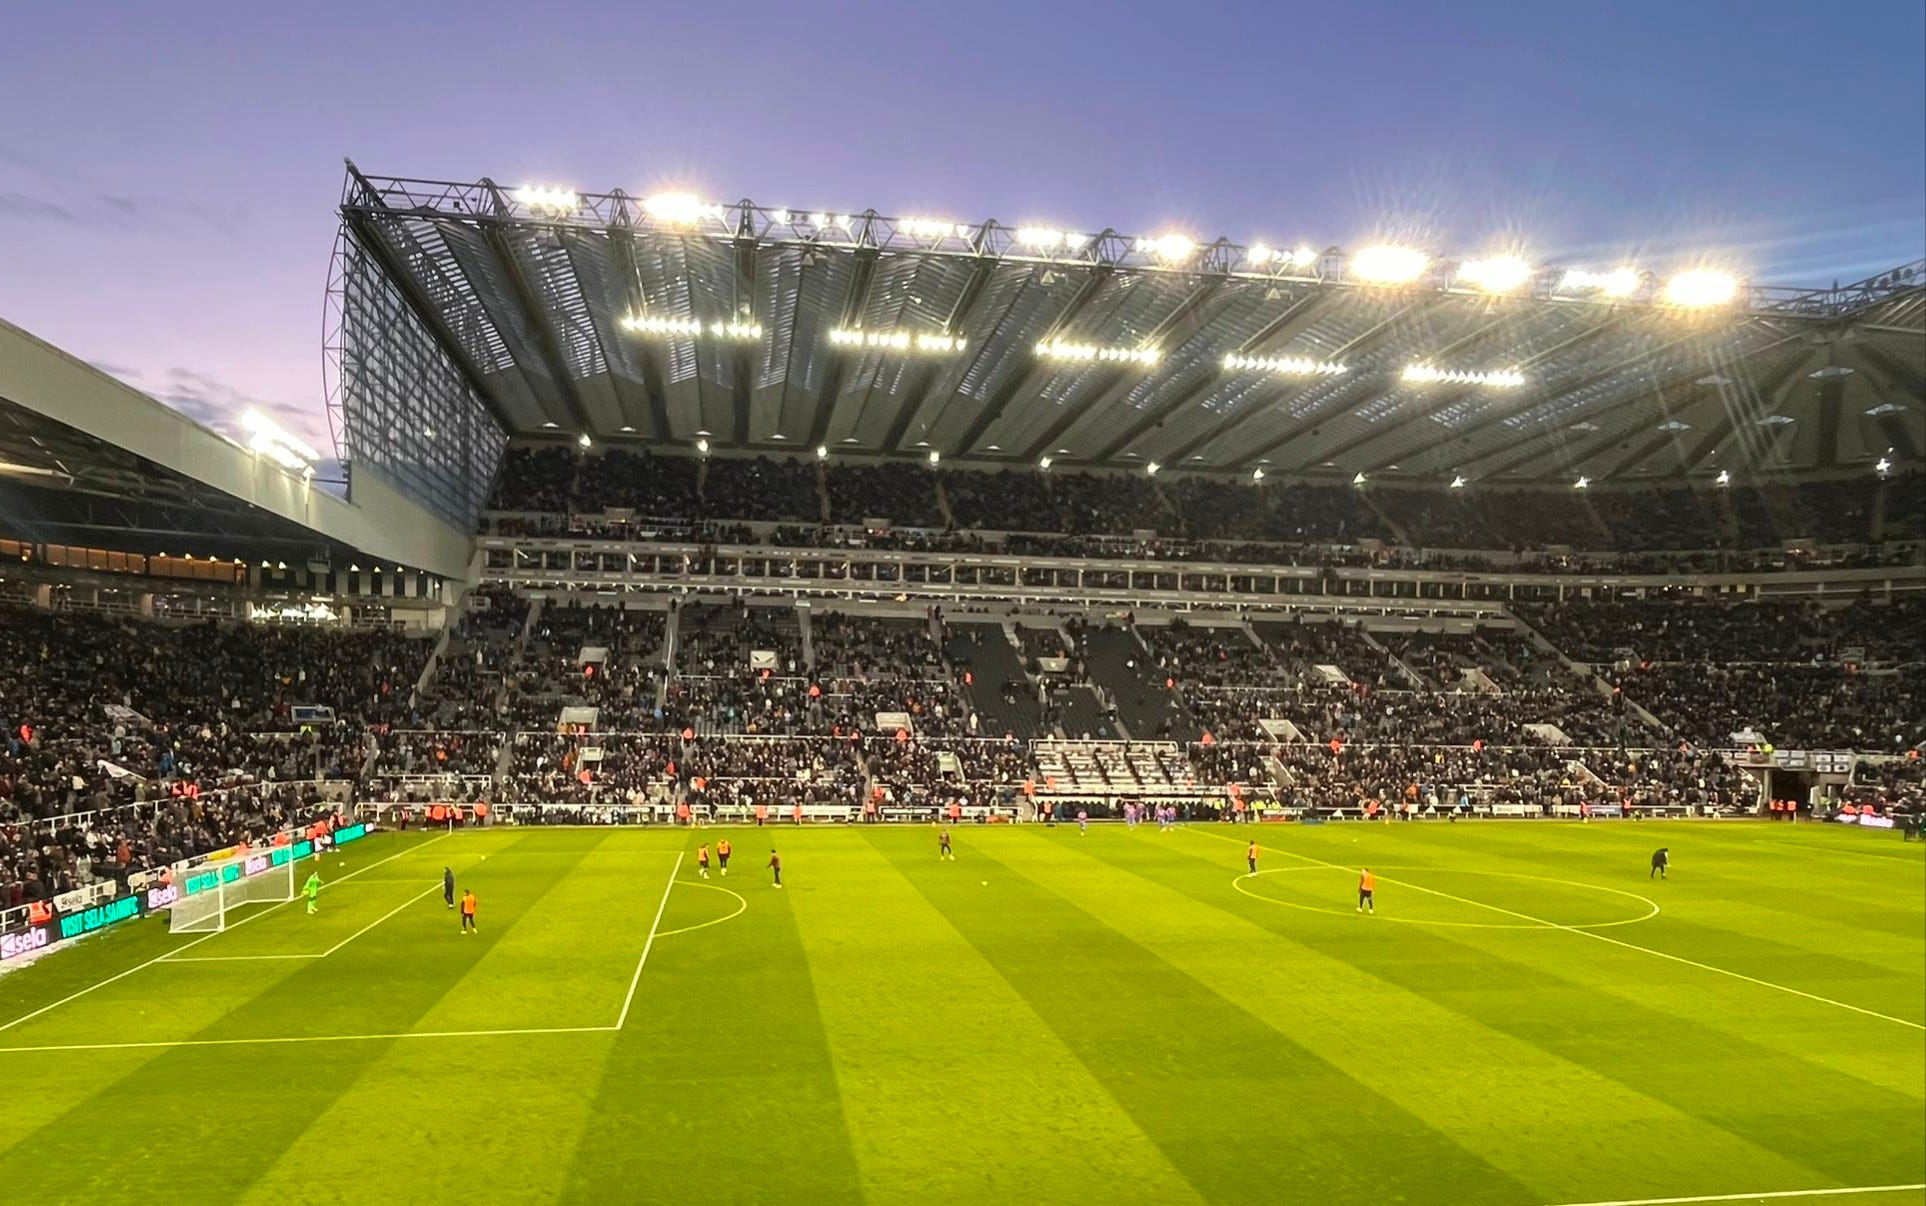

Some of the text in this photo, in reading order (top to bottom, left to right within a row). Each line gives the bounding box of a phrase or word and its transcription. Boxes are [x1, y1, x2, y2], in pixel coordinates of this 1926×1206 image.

[158, 885, 178, 904] sela
[61, 913, 83, 938] VISIT
[15, 926, 46, 953] sela
